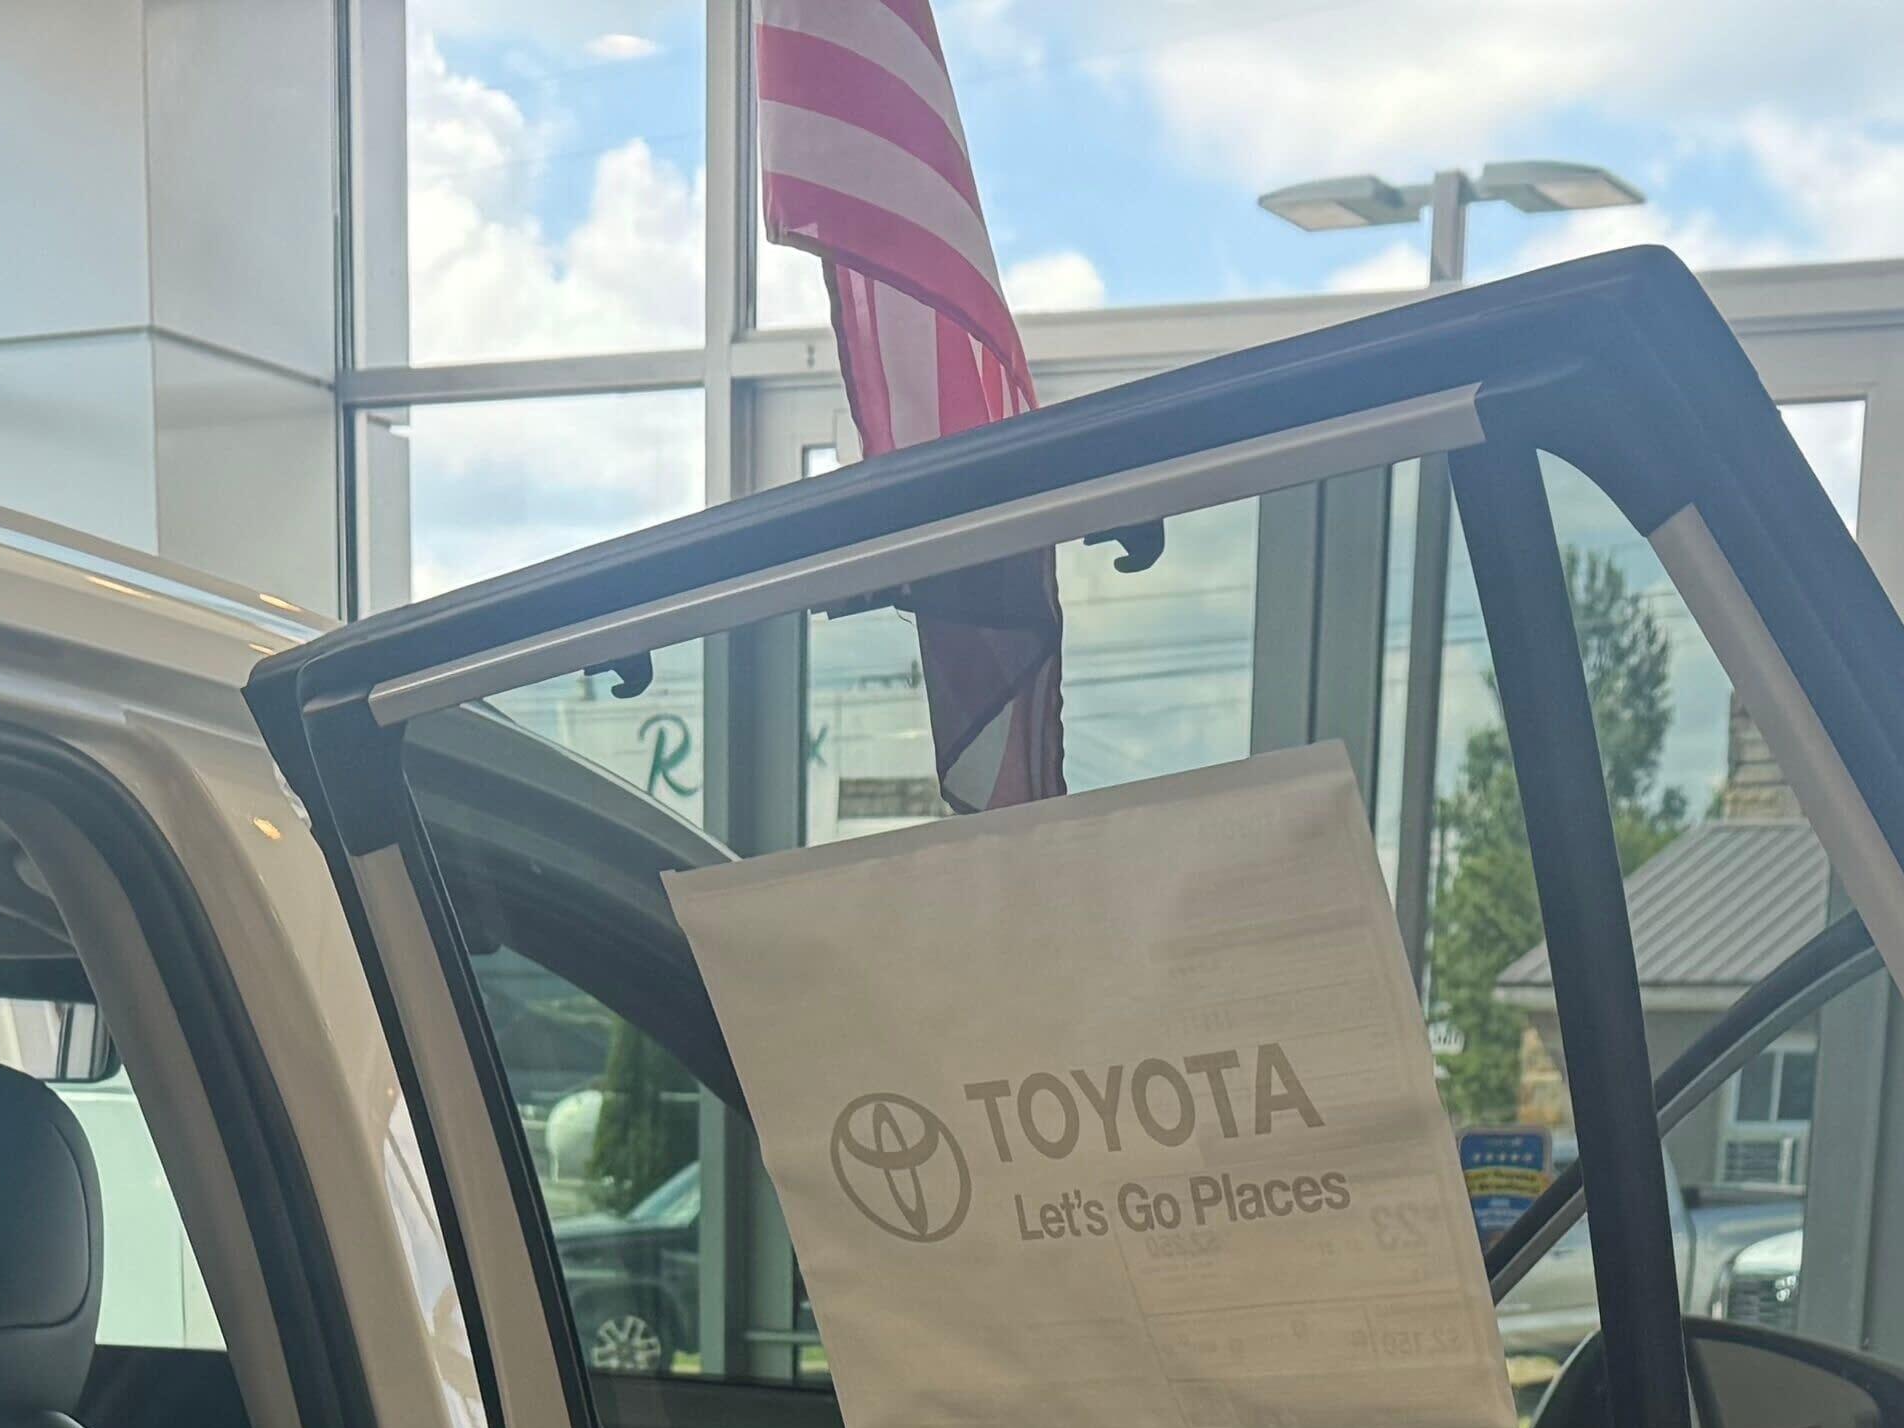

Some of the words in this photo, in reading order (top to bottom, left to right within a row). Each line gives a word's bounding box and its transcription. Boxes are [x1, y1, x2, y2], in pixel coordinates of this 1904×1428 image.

[963, 1042, 1326, 1163] TOYOTA
[1014, 1189, 1109, 1241] Let's
[1117, 1182, 1182, 1233] Go
[1189, 1171, 1351, 1226] Places
